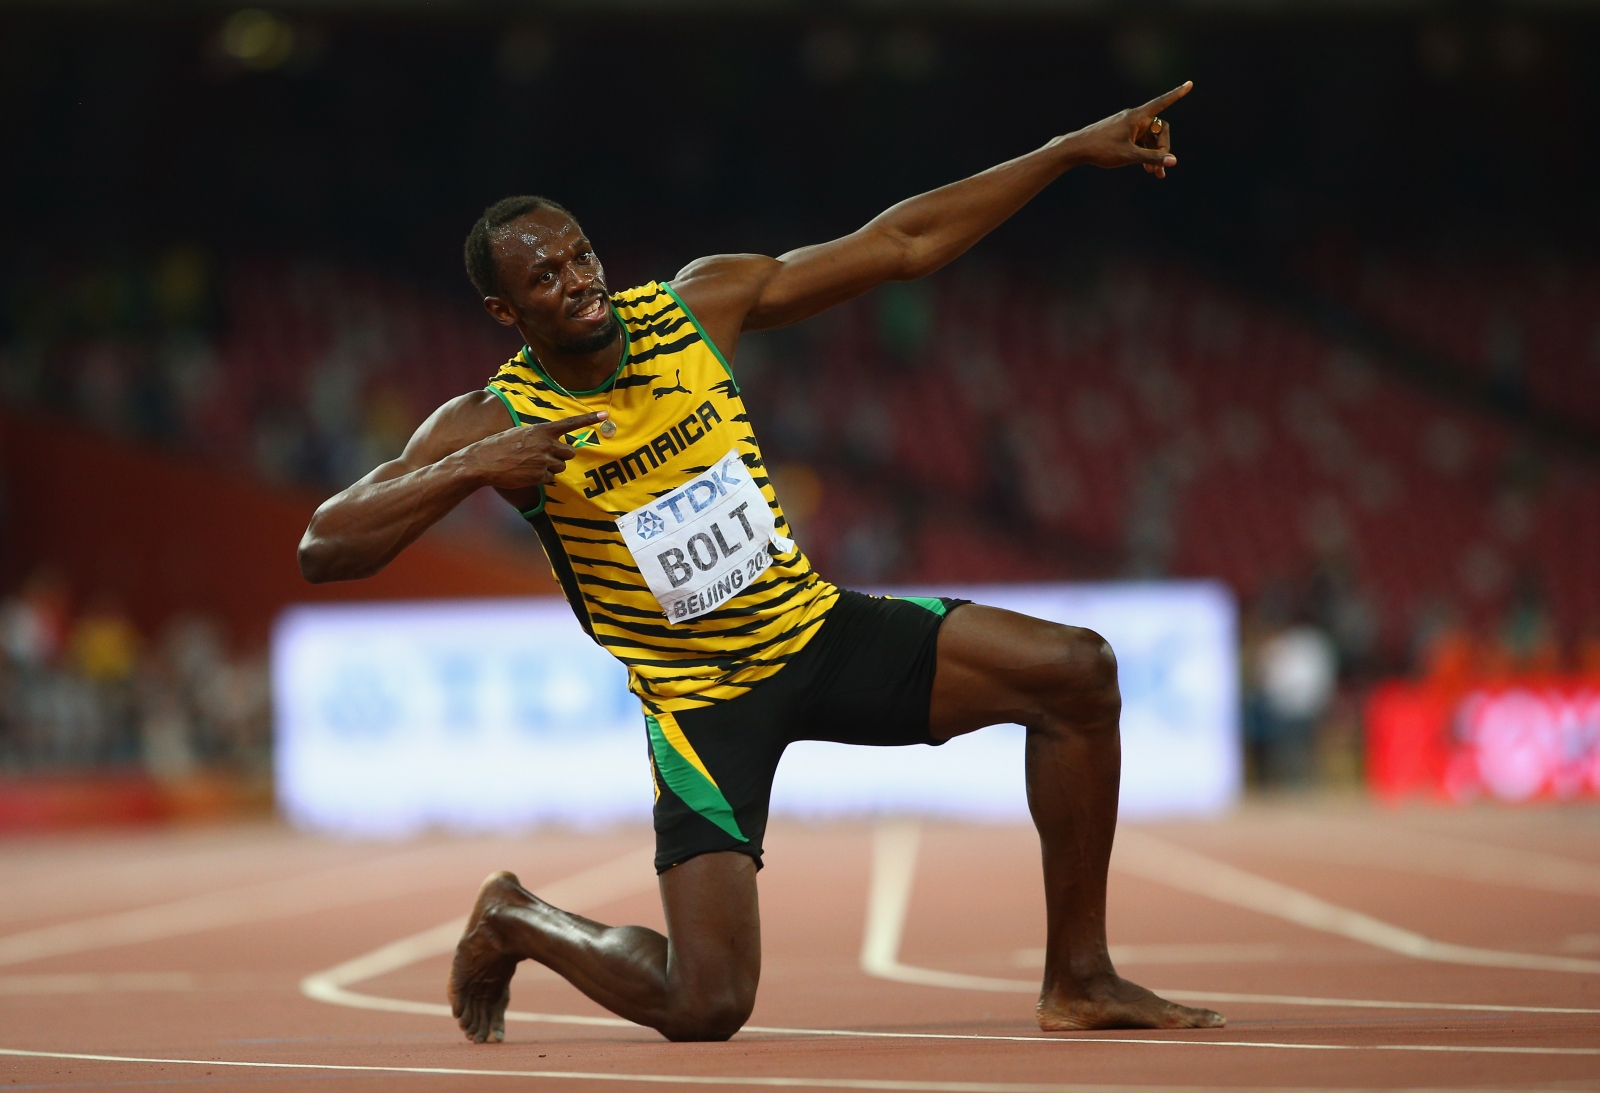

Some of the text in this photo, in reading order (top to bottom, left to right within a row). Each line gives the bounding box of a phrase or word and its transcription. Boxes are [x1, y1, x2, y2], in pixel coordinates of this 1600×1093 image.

[583, 400, 722, 499] JAMAICA
[656, 458, 741, 524] TDK
[657, 501, 754, 588] BOLT
[673, 569, 743, 619] BEIJING
